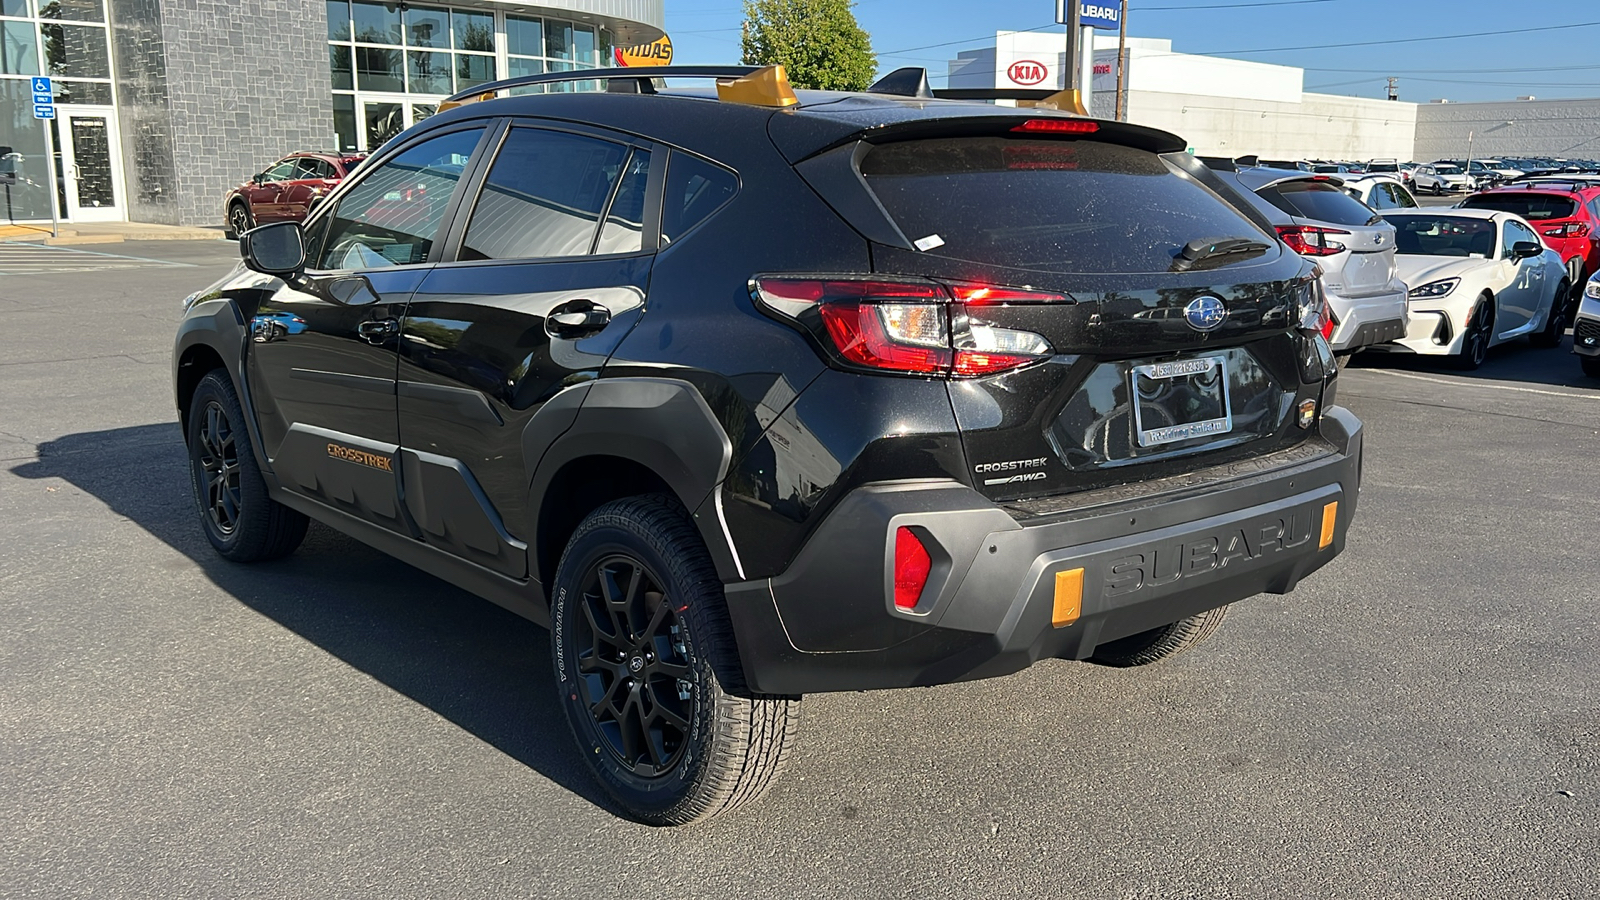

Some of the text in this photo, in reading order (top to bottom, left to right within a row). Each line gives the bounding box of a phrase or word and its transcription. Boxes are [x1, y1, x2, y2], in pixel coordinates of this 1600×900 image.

[1079, 4, 1117, 21] UBARU
[621, 43, 671, 59] MIDAS
[1014, 65, 1041, 80] KIA
[327, 443, 393, 472] CROSSTREK
[975, 457, 1047, 473] CROSSTREK
[1009, 472, 1047, 483] AWD
[1105, 509, 1314, 597] SUBARU
[555, 587, 567, 682] YOKOHAMA
